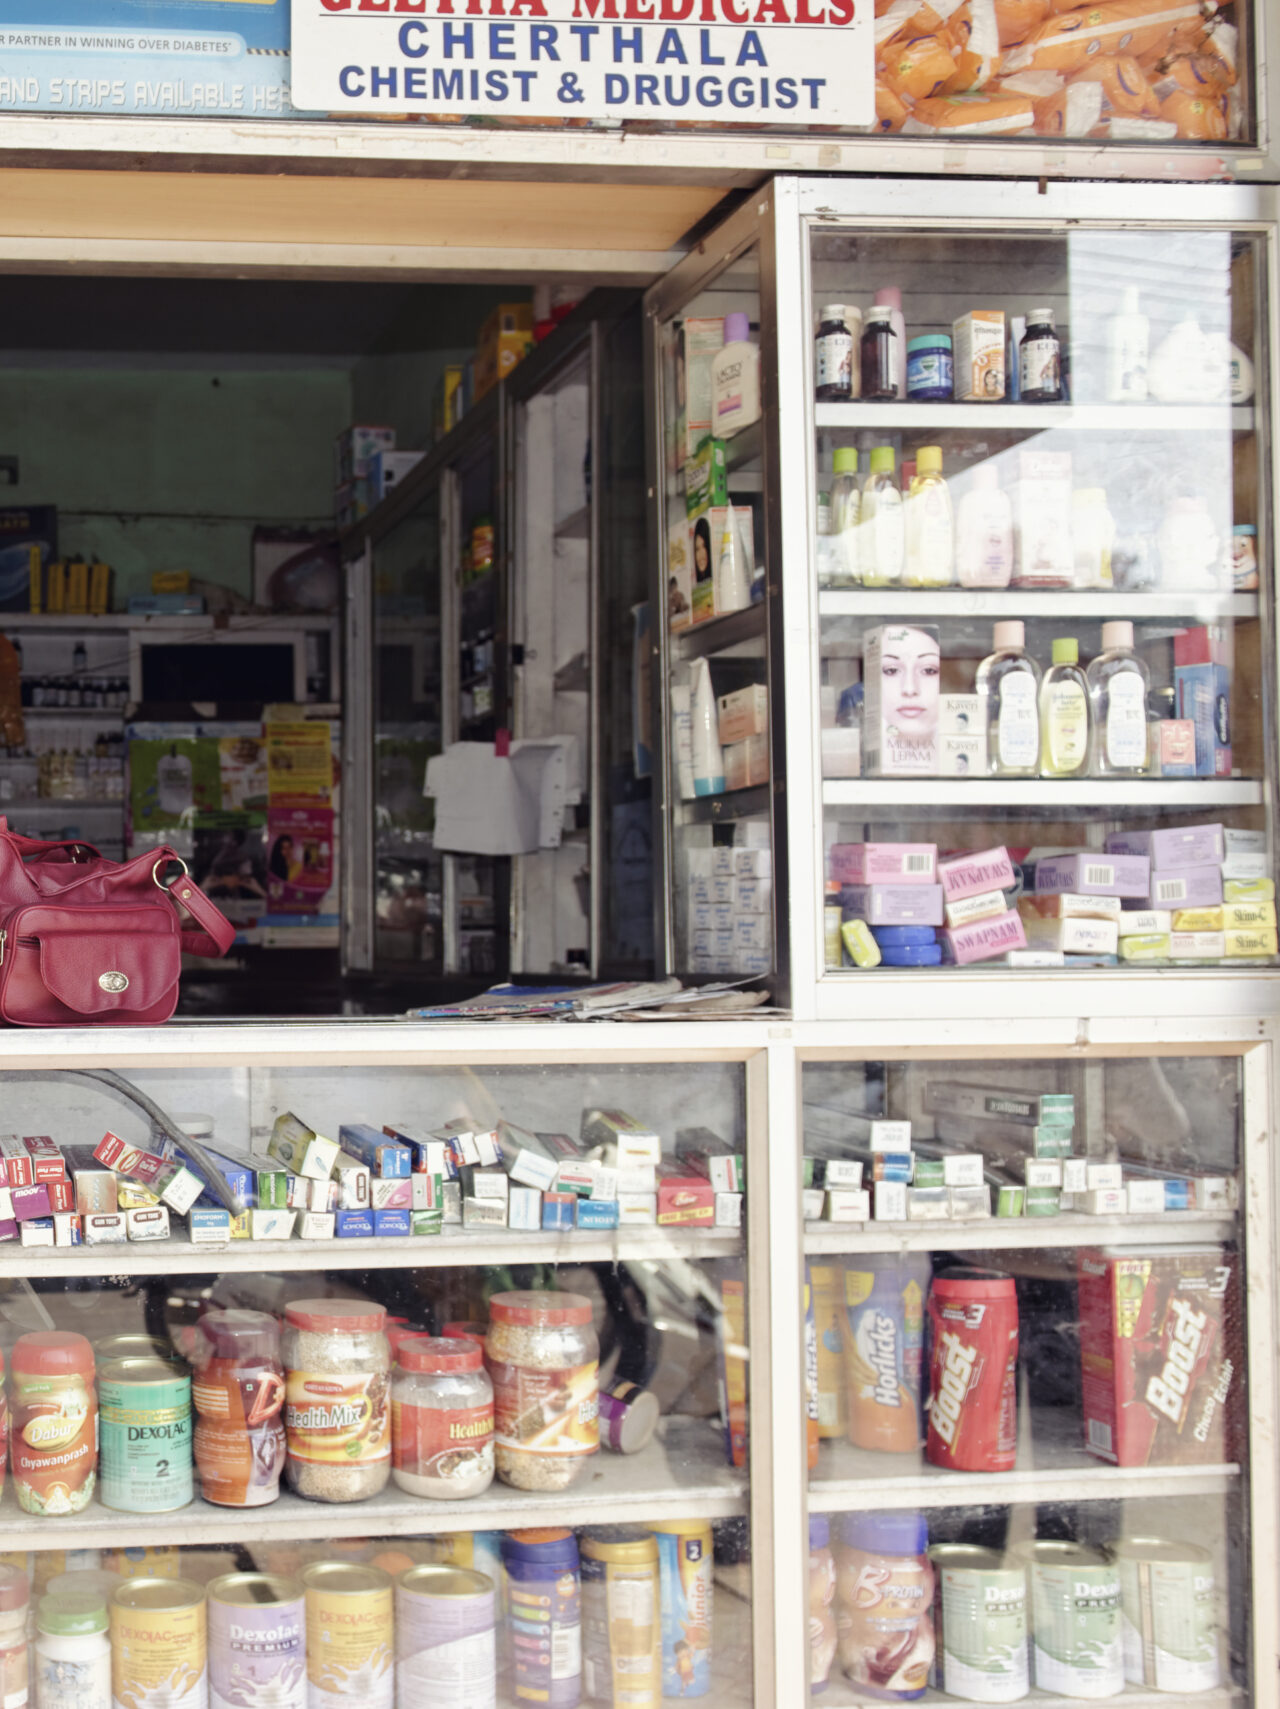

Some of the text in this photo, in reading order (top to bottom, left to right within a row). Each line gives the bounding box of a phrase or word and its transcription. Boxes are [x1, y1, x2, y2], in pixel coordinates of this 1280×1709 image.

[8, 35, 61, 46] PARTNER
[65, 36, 76, 47] IN
[80, 37, 134, 49] WINNING
[138, 39, 170, 50] OVER
[398, 21, 768, 66] CHERTHALA
[49, 78, 127, 108] STRIPS
[134, 81, 245, 110] AVAILABLE
[339, 65, 826, 109] CHEMIST & DRUGGIST
[947, 700, 978, 711] Kaveri
[887, 739, 935, 749] MUKHA
[947, 741, 978, 752] Kaveri
[892, 751, 931, 763] LEPAM
[949, 862, 1010, 889] SWAPNAM
[957, 922, 1017, 950] SWAPNAM
[870, 1314, 900, 1408] Horlicks
[1194, 1359, 1234, 1442] Choco Eclair
[287, 1404, 362, 1431] Health Mix
[31, 1422, 73, 1443] Dabur
[128, 1421, 187, 1441] DEXOLAC
[449, 1418, 485, 1440] Health
[20, 1445, 89, 1468] Chyawanprash
[156, 1460, 170, 1478] 2
[689, 1544, 699, 1560] 2
[120, 1626, 171, 1644] DEXOLAC
[230, 1624, 300, 1642] Dexolac
[231, 1640, 299, 1653] PREMIUM
[248, 1666, 256, 1677] 1
